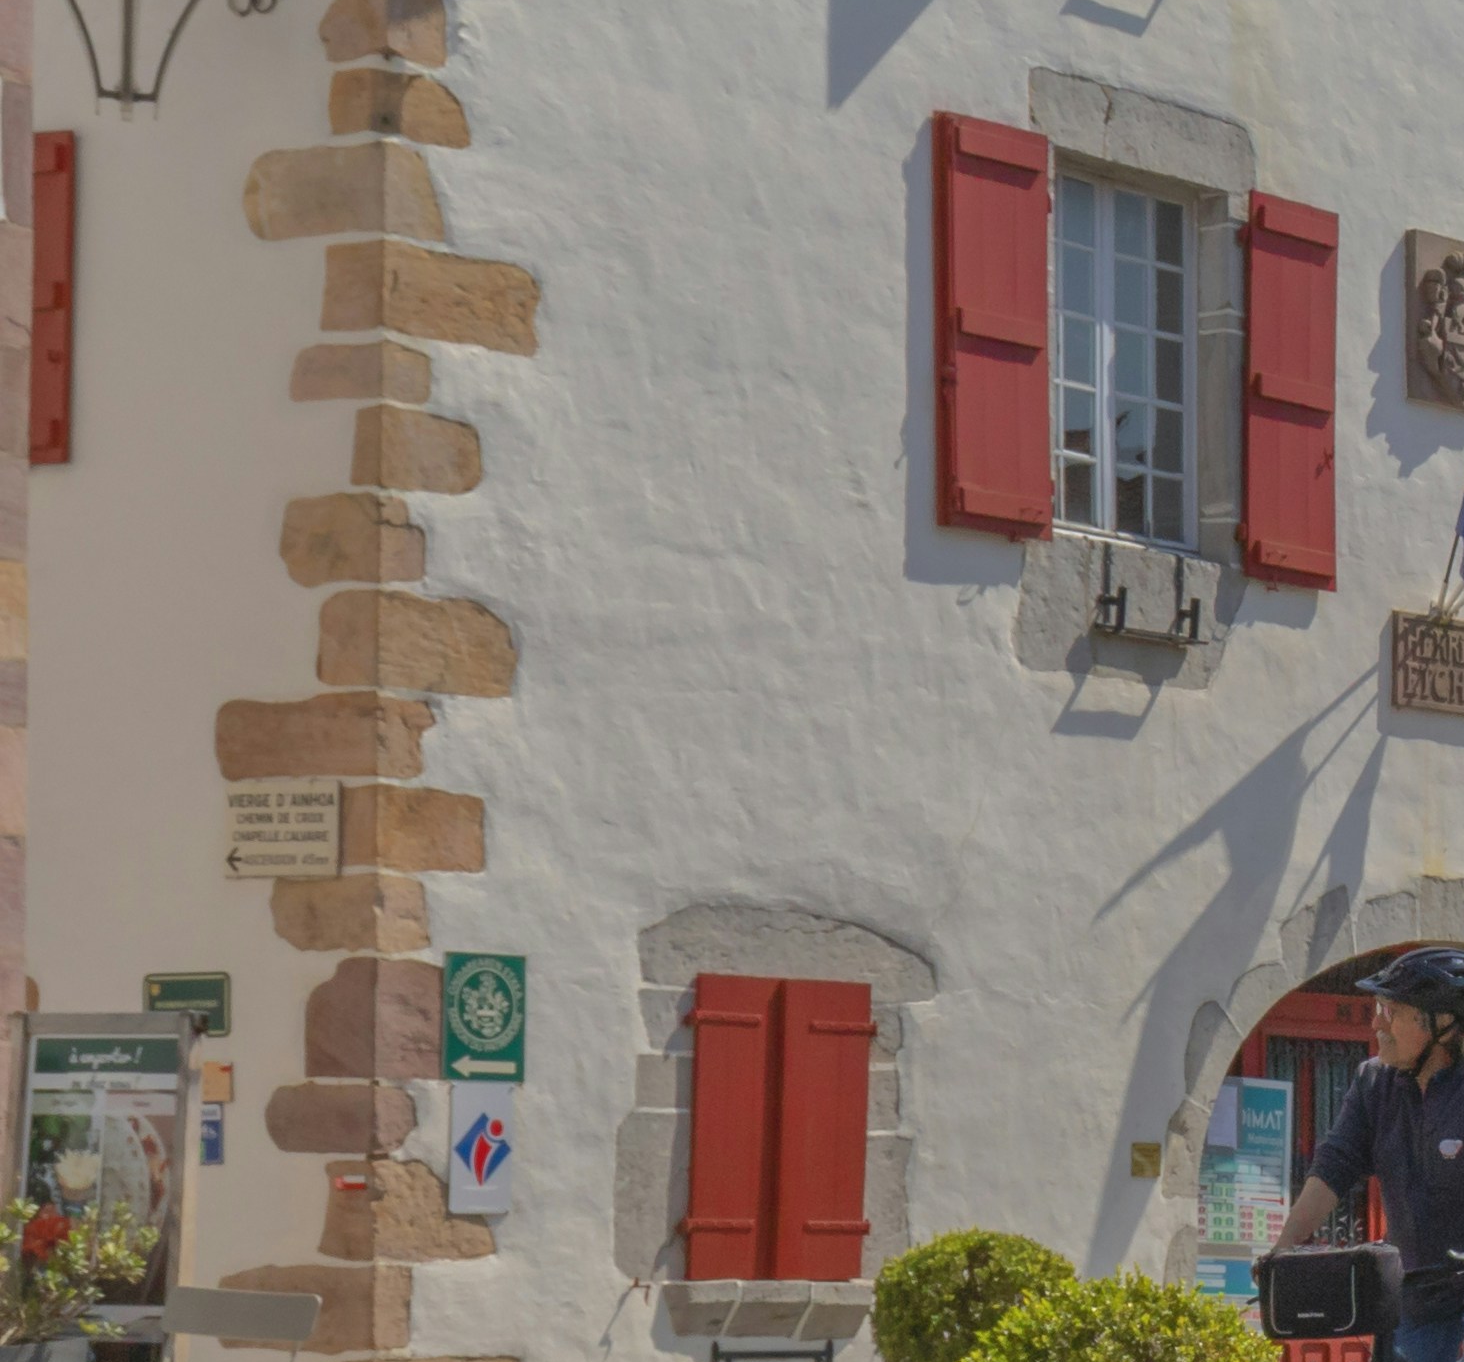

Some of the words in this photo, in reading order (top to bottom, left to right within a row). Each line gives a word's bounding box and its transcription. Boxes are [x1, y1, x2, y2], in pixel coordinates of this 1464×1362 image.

[228, 793, 270, 808] VIERGE
[236, 812, 274, 824] CHEMIN
[277, 812, 290, 824] DE
